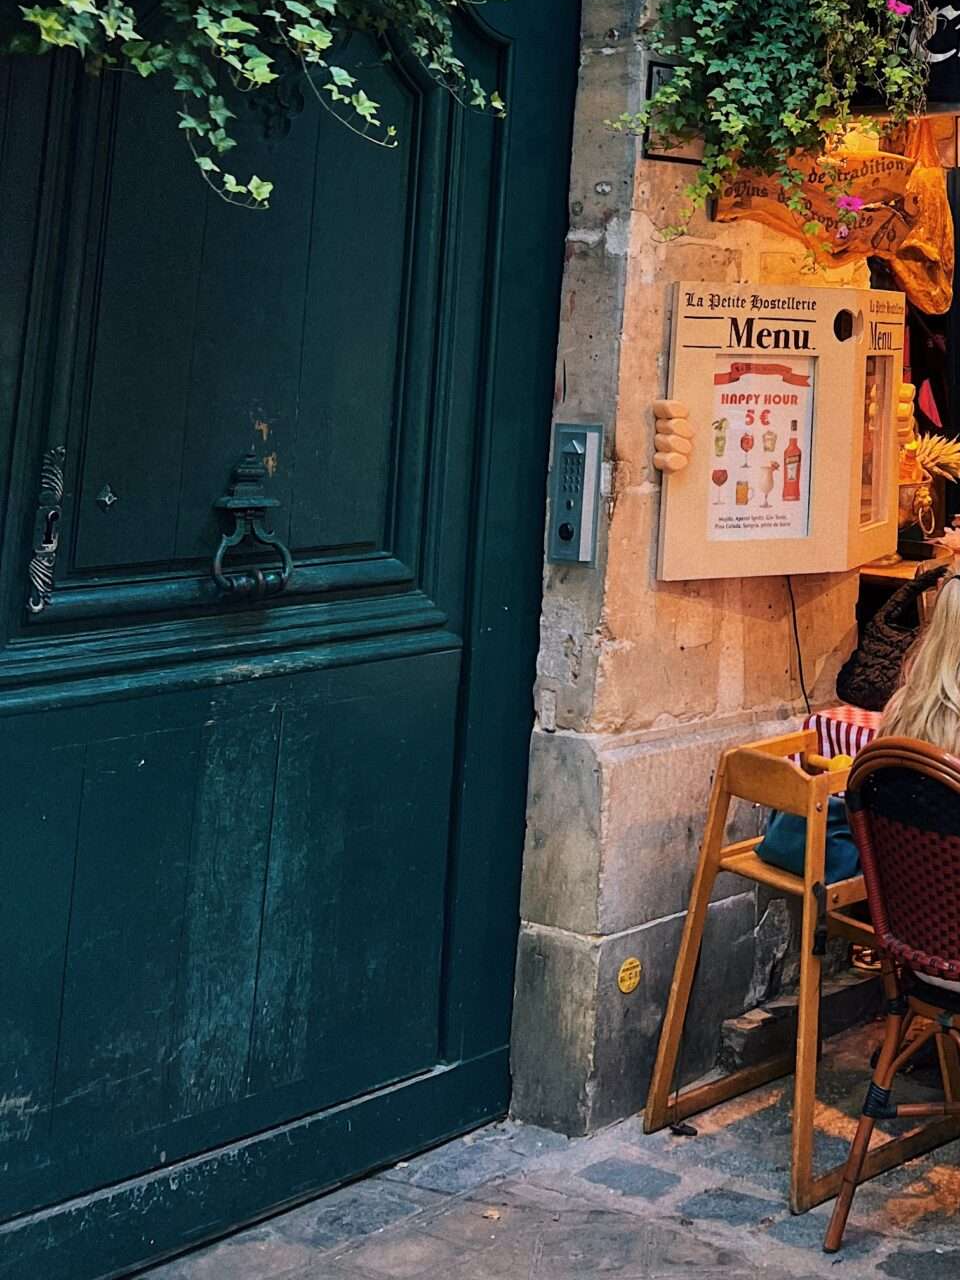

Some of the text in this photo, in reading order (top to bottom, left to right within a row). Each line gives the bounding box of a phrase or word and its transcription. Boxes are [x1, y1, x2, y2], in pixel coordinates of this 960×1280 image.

[808, 157, 905, 183] de tradition
[685, 292, 816, 311] La Petite Hostellerie
[721, 393, 798, 405] HAPPY HOUR
